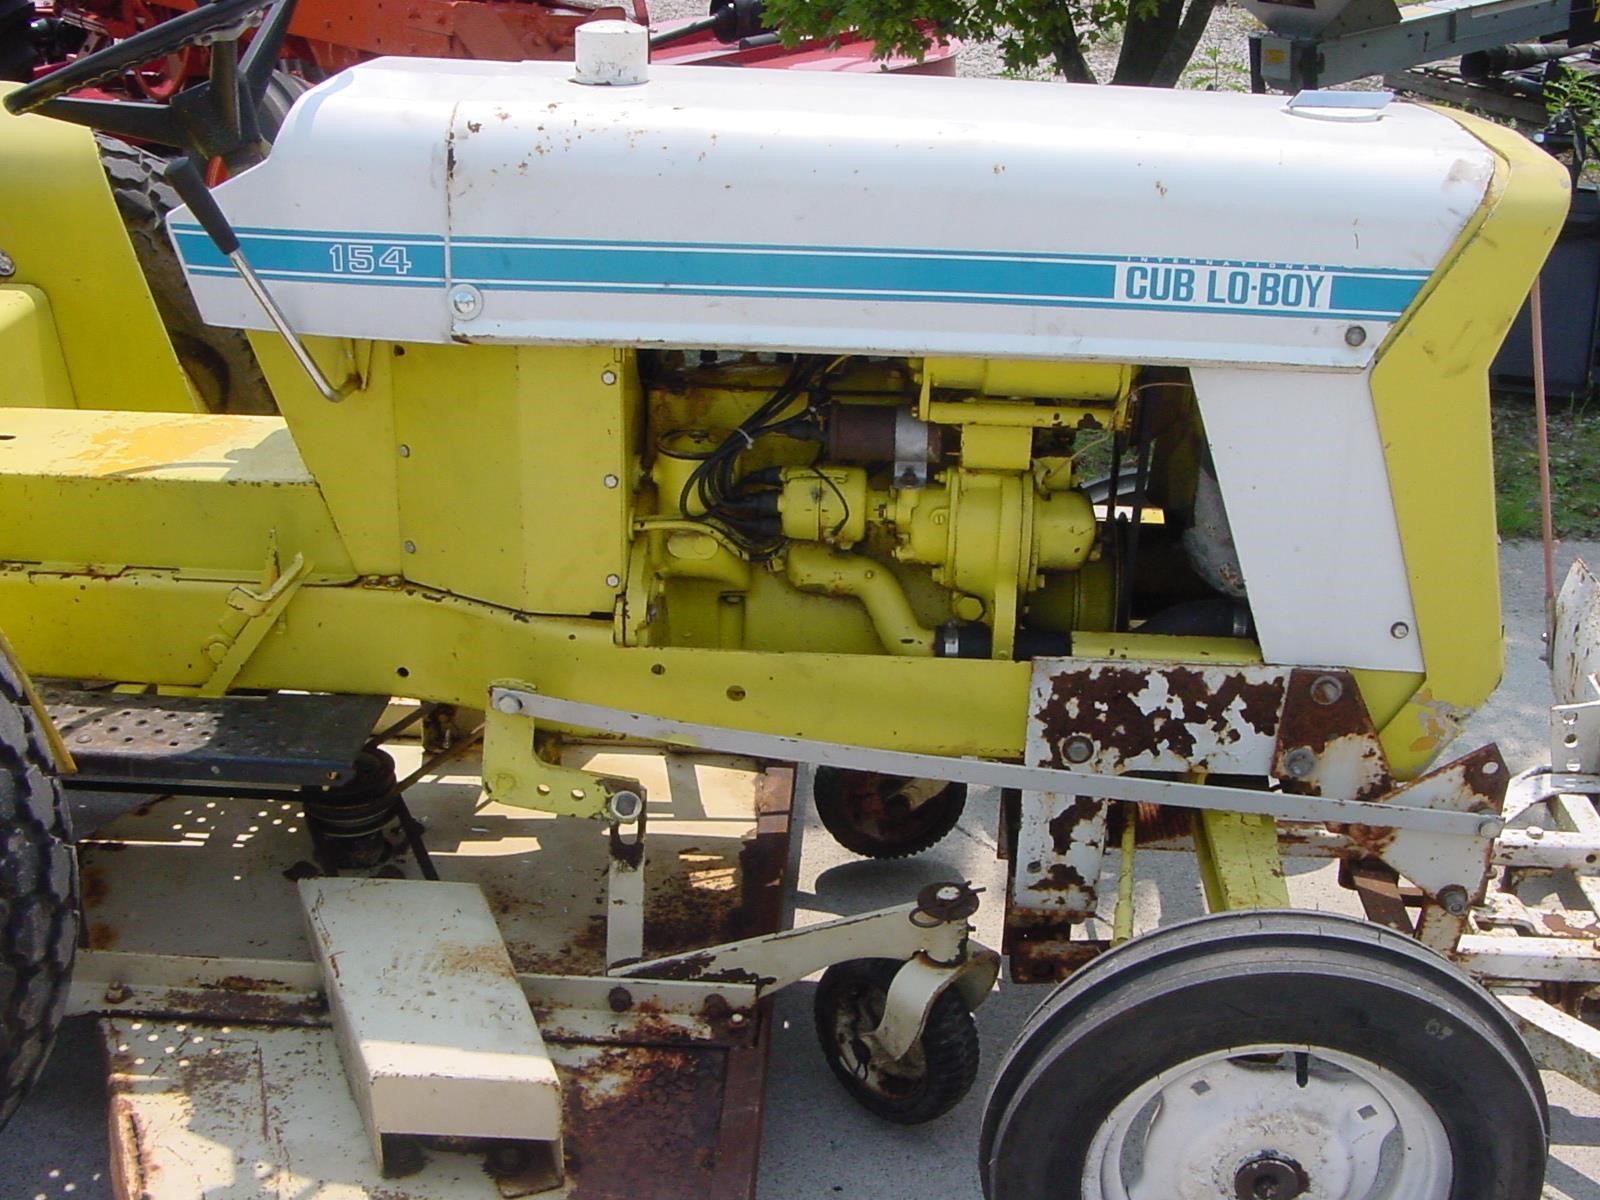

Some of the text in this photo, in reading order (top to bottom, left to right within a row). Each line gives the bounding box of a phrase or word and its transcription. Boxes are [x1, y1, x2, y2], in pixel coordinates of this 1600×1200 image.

[329, 244, 412, 275] 154
[1126, 266, 1325, 308] CUB LO-BOY
